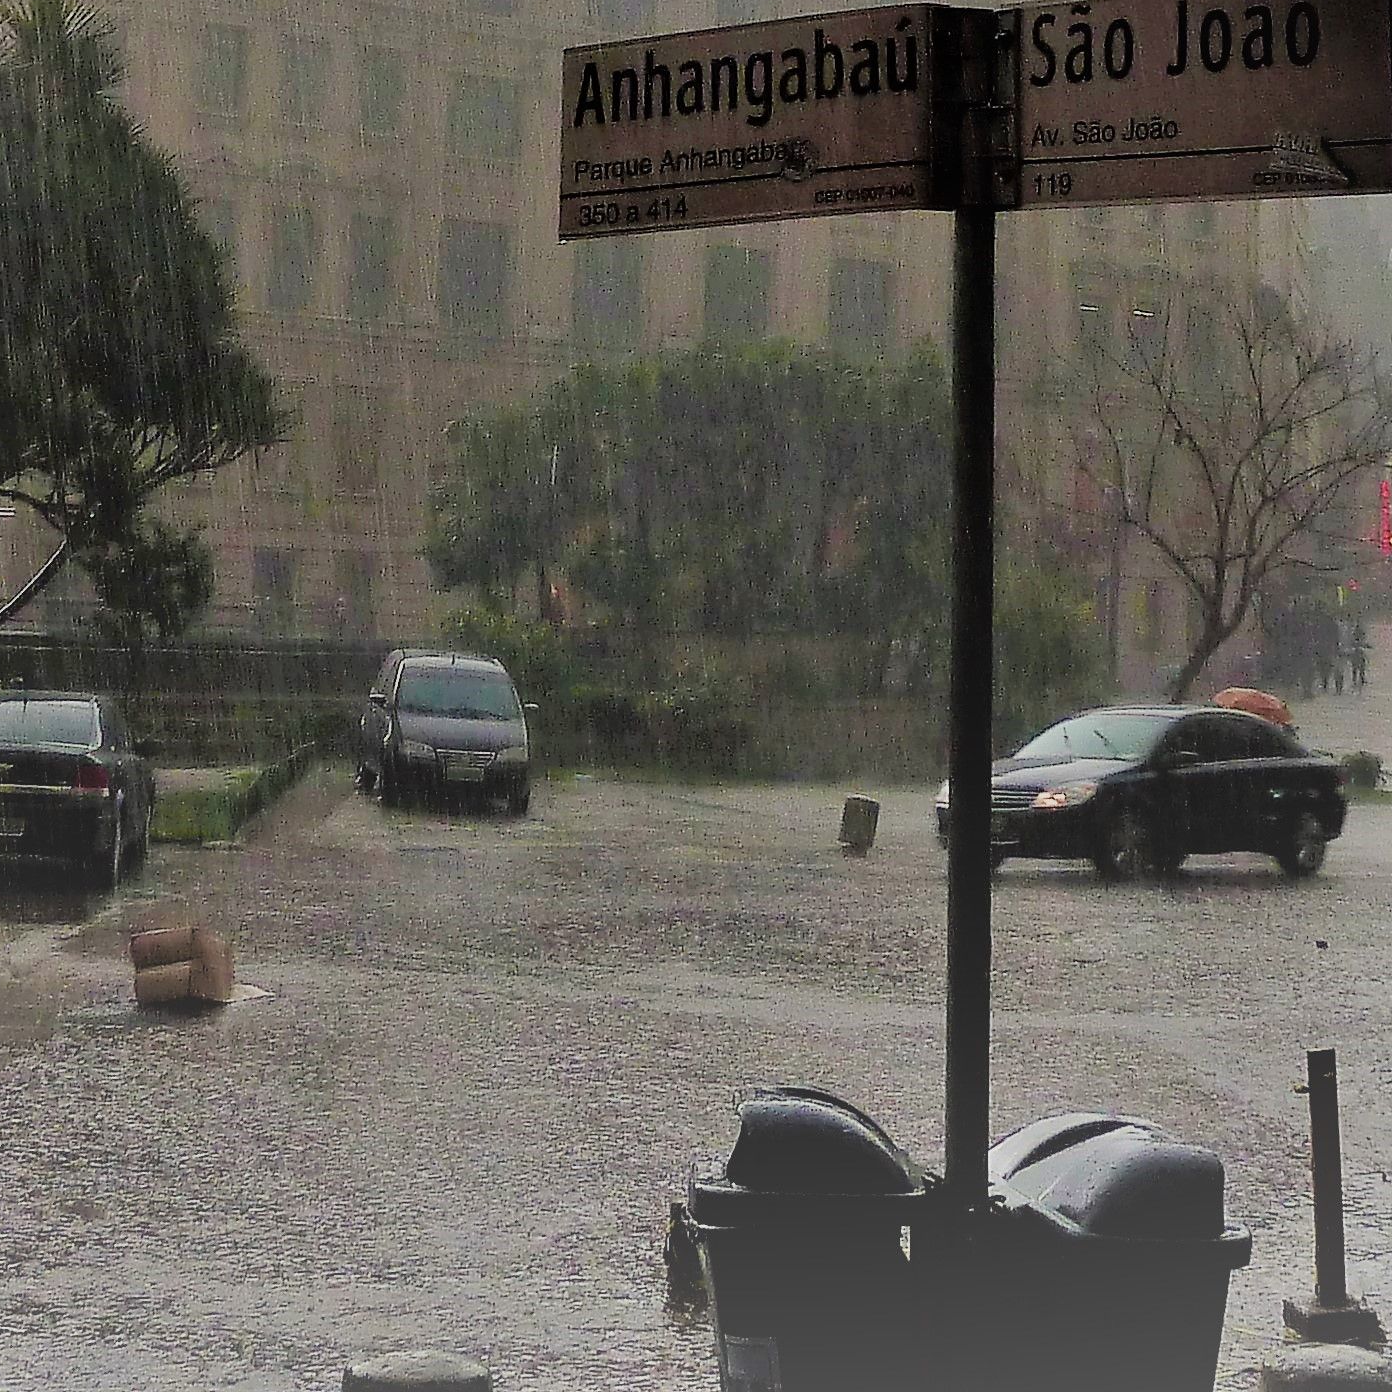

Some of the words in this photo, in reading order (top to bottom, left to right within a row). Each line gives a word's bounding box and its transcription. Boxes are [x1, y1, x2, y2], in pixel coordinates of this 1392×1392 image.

[1029, 4, 1134, 88] São
[573, 16, 919, 128] Anhangabaú
[1030, 124, 1064, 148] Av.
[1072, 120, 1116, 146] São
[1122, 117, 1179, 143] João
[574, 157, 653, 184] Parque
[660, 135, 812, 173] Anhangaba
[1033, 171, 1073, 196] 119
[626, 205, 640, 224] a
[646, 192, 688, 221] 414
